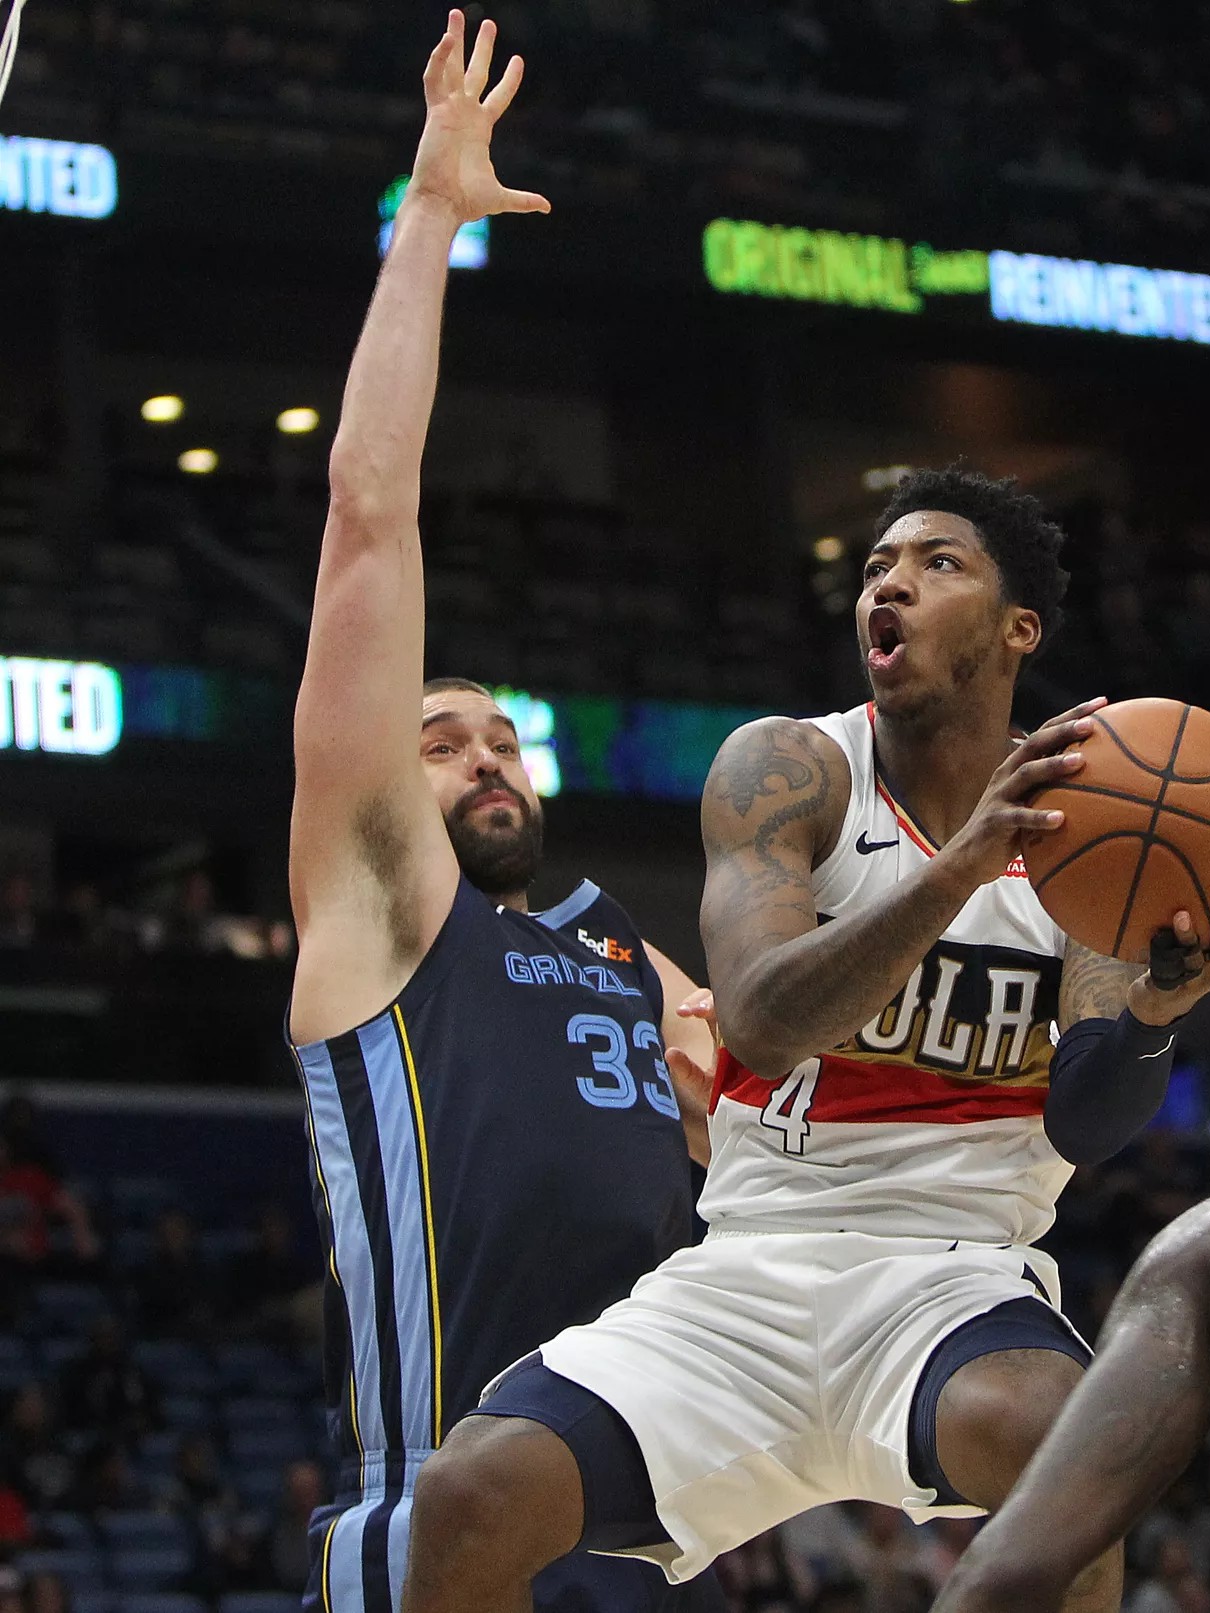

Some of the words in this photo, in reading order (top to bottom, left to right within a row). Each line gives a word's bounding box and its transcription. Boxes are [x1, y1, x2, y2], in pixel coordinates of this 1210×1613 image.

[577, 928, 633, 963] FedEx
[566, 1012, 680, 1121] 33
[761, 1056, 822, 1156] 4
